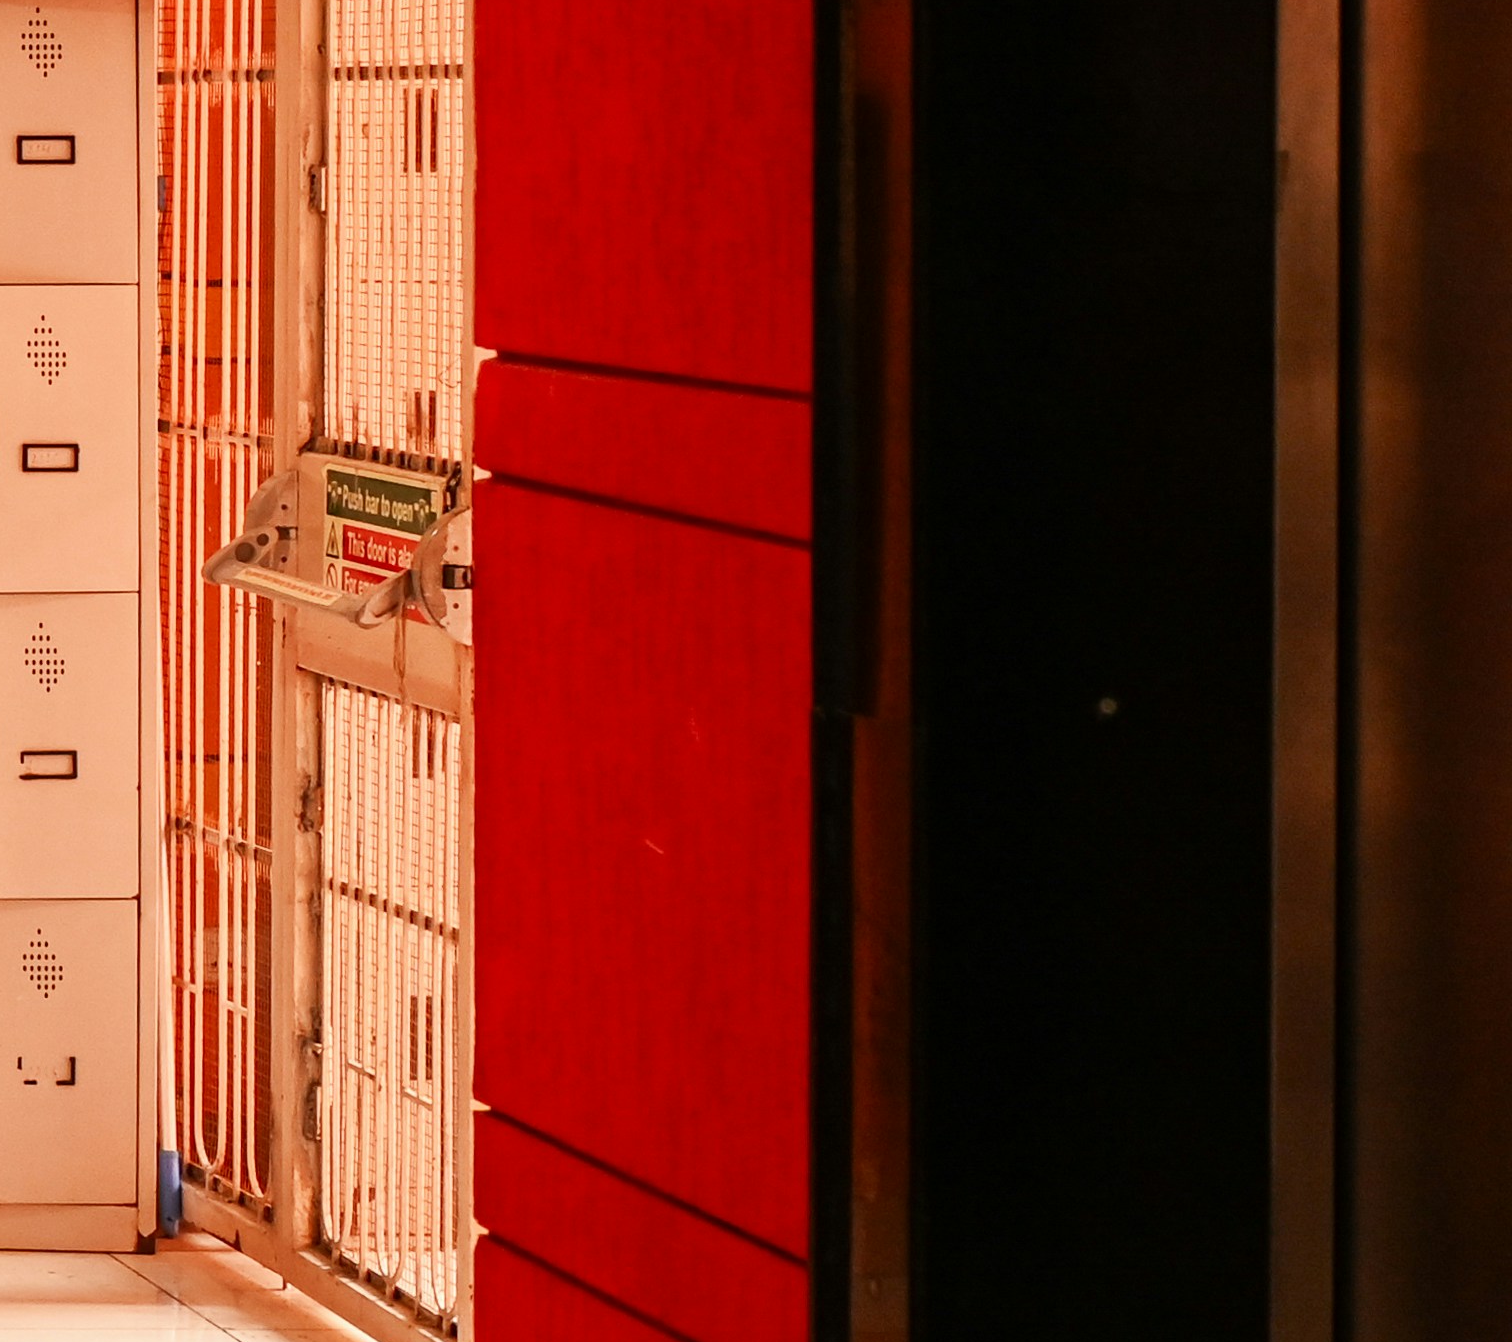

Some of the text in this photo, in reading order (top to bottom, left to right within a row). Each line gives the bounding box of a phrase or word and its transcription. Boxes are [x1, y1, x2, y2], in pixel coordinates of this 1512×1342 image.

[342, 484, 414, 527] Push bar to open
[347, 531, 366, 559] This
[367, 536, 386, 563] door
[388, 540, 397, 566] is
